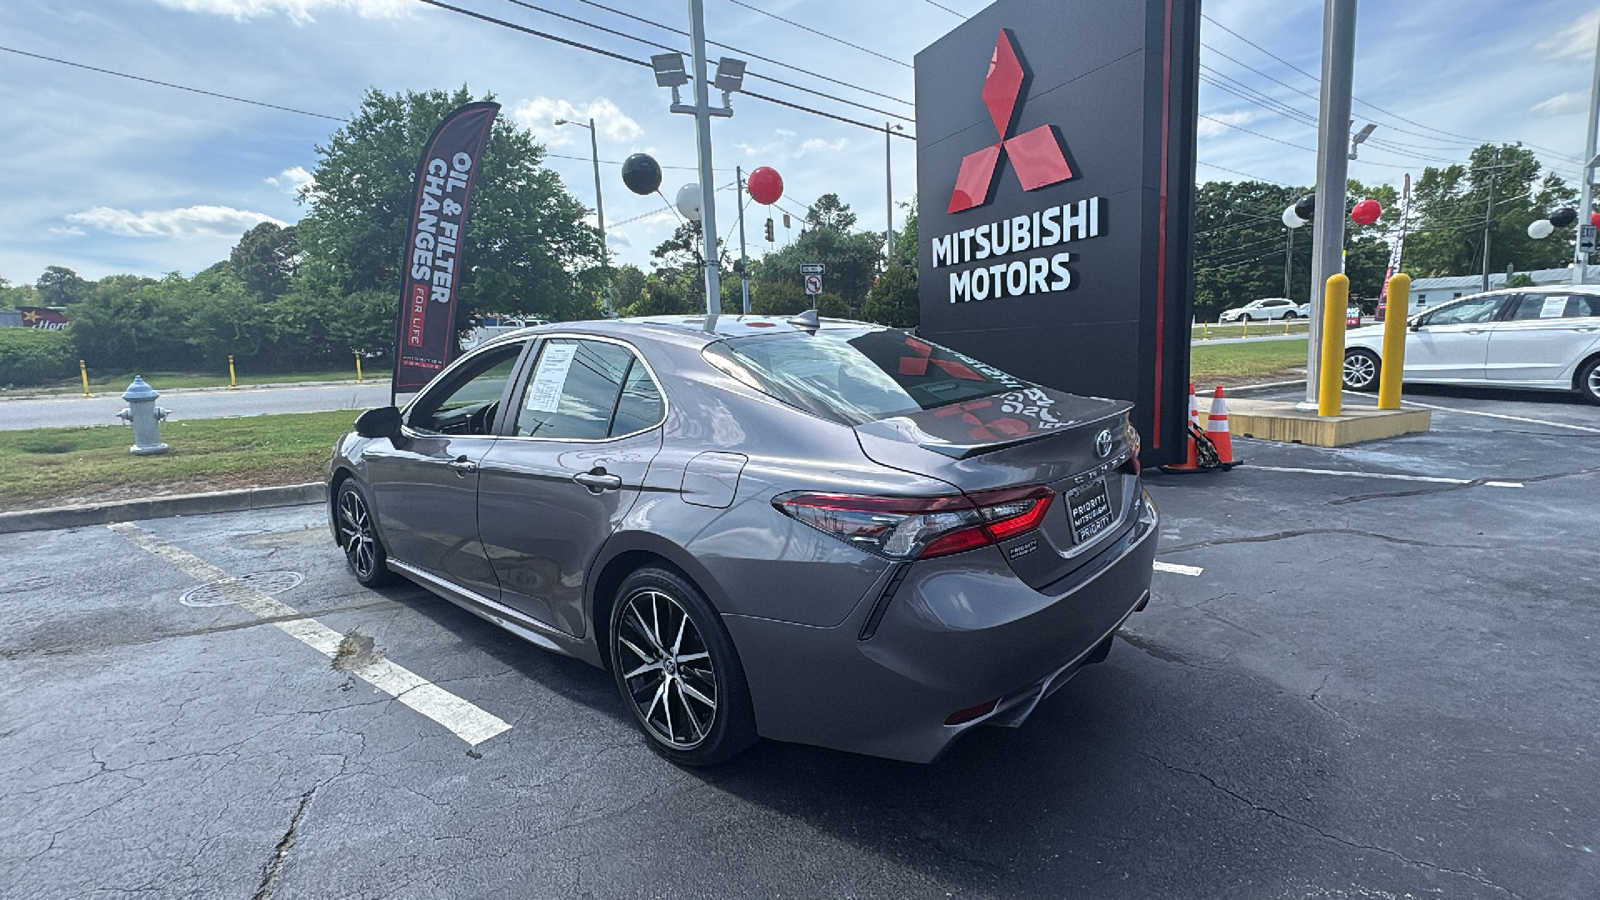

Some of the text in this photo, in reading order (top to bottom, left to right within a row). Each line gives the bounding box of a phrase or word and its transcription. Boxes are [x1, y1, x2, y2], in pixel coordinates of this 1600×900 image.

[411, 158, 448, 281] CHANGES
[431, 152, 472, 304] OIL & FILTER
[932, 196, 1098, 269] MITSUBISHI
[950, 252, 1071, 304] MOTORS
[411, 288, 424, 344] FOR LIFE
[1072, 494, 1106, 517] PRIORITY
[1080, 517, 1110, 540] PRIORITY
[1010, 540, 1037, 554] PRIORITY
